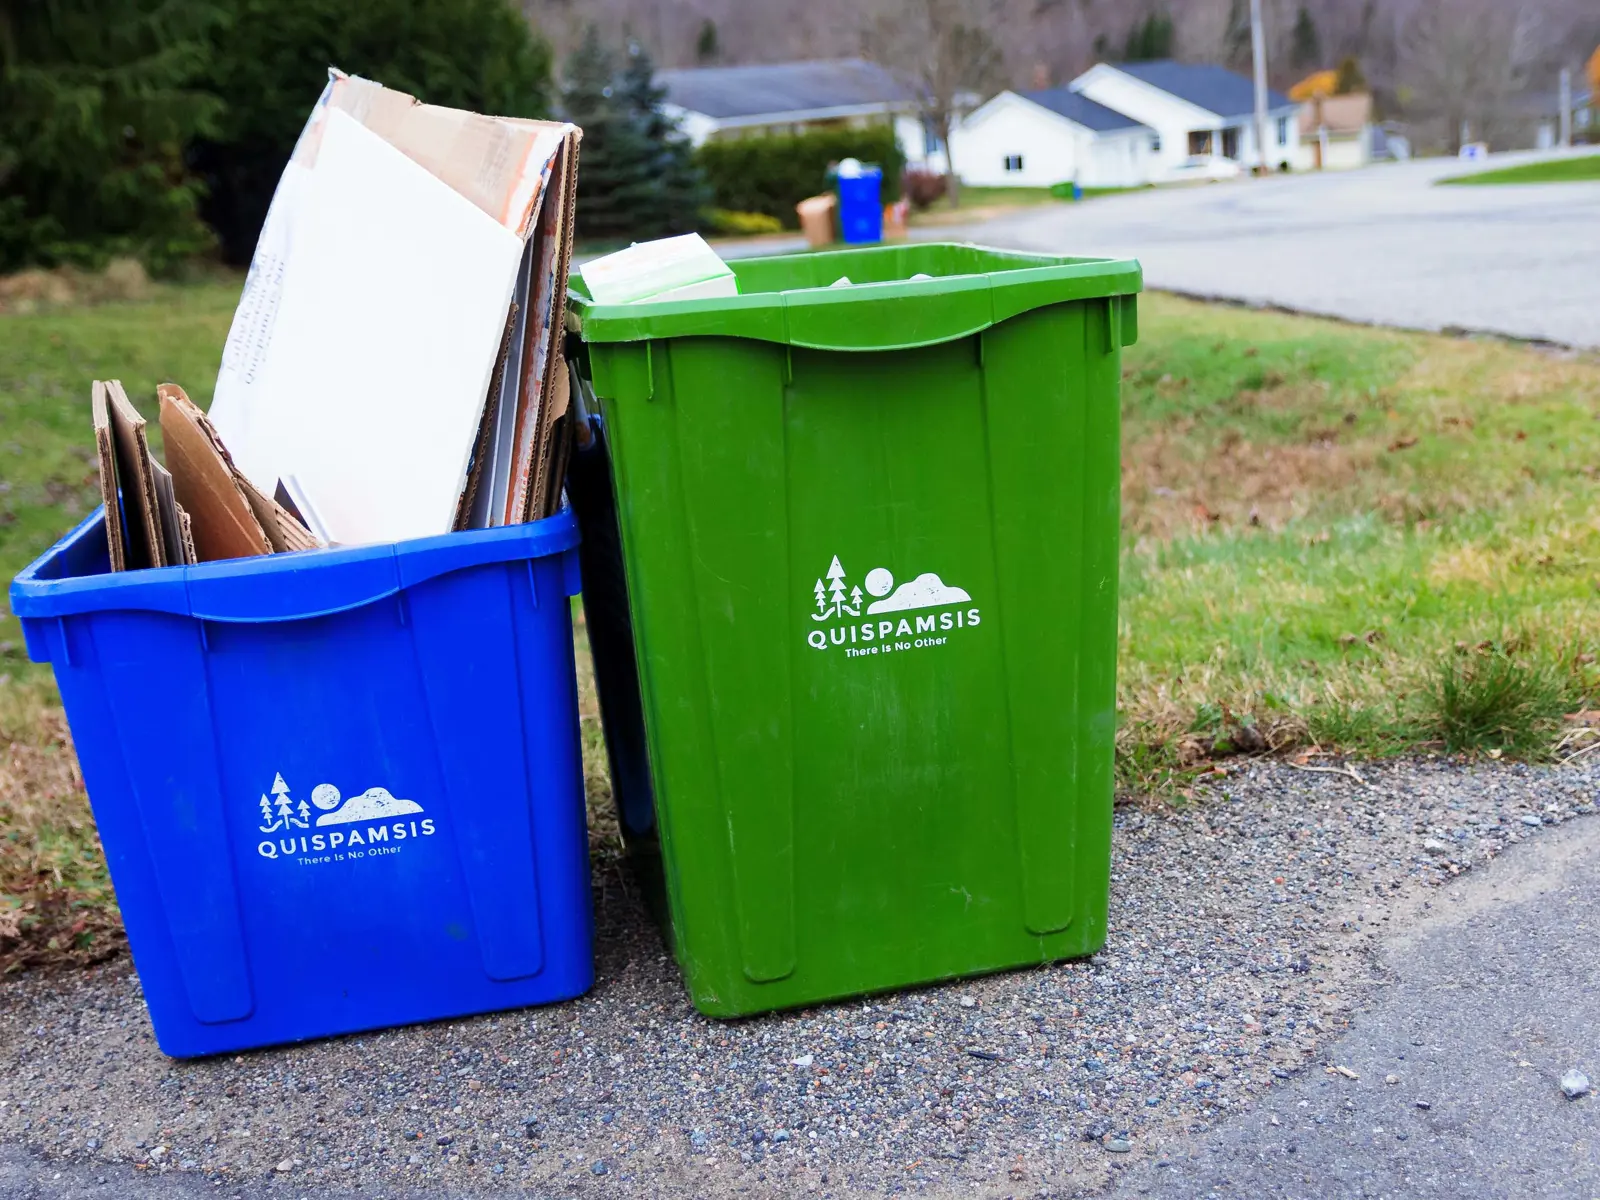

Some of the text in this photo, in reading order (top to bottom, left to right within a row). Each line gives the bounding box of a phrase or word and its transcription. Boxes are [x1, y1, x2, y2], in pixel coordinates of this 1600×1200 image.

[807, 608, 981, 650] QUISPAMSIS
[844, 636, 947, 658] There Is No Other
[257, 819, 436, 859] QUISPAMSIS
[297, 845, 402, 866] There Is No Other
